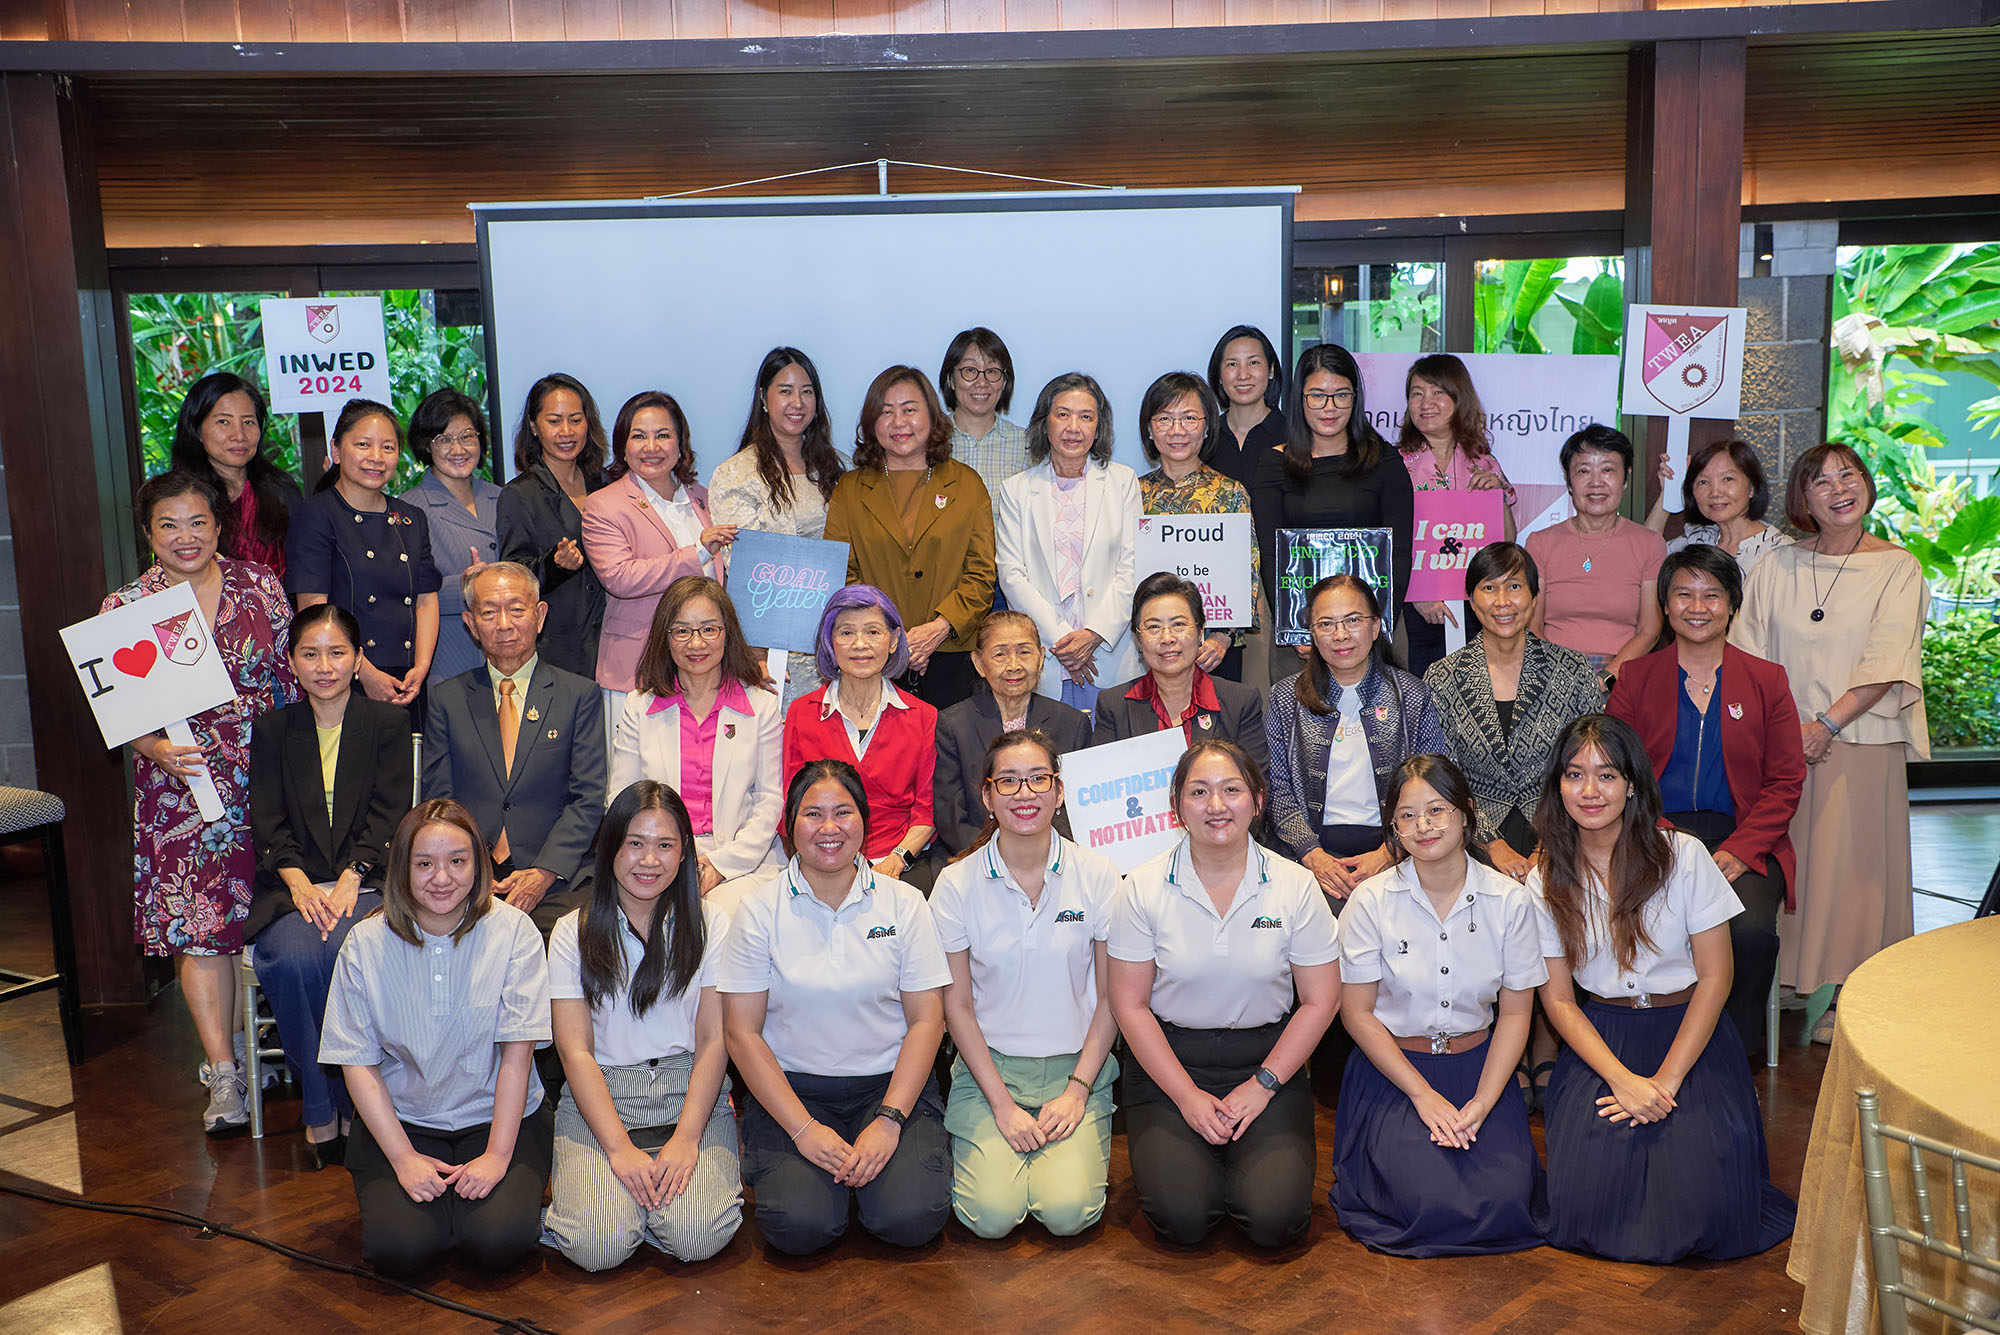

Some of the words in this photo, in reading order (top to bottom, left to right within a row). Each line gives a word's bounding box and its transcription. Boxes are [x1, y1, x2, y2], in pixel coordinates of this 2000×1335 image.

[1648, 325, 1707, 372] TWEA
[280, 352, 375, 374] INWED
[299, 375, 362, 395] 2024
[1161, 522, 1224, 542] Proud
[1337, 532, 1362, 541] 2024
[1415, 520, 1429, 540] I
[1432, 522, 1485, 540] can
[1439, 537, 1463, 556] &
[1412, 550, 1426, 570] I
[1429, 546, 1483, 570] wil
[752, 562, 830, 591] GOAL
[1176, 565, 1189, 577] to
[1193, 564, 1209, 576] be
[747, 578, 827, 618] Getter
[164, 619, 187, 651] TWEA
[78, 657, 114, 699] I
[1077, 765, 1177, 807] CONFIDENT
[1126, 796, 1144, 818] &
